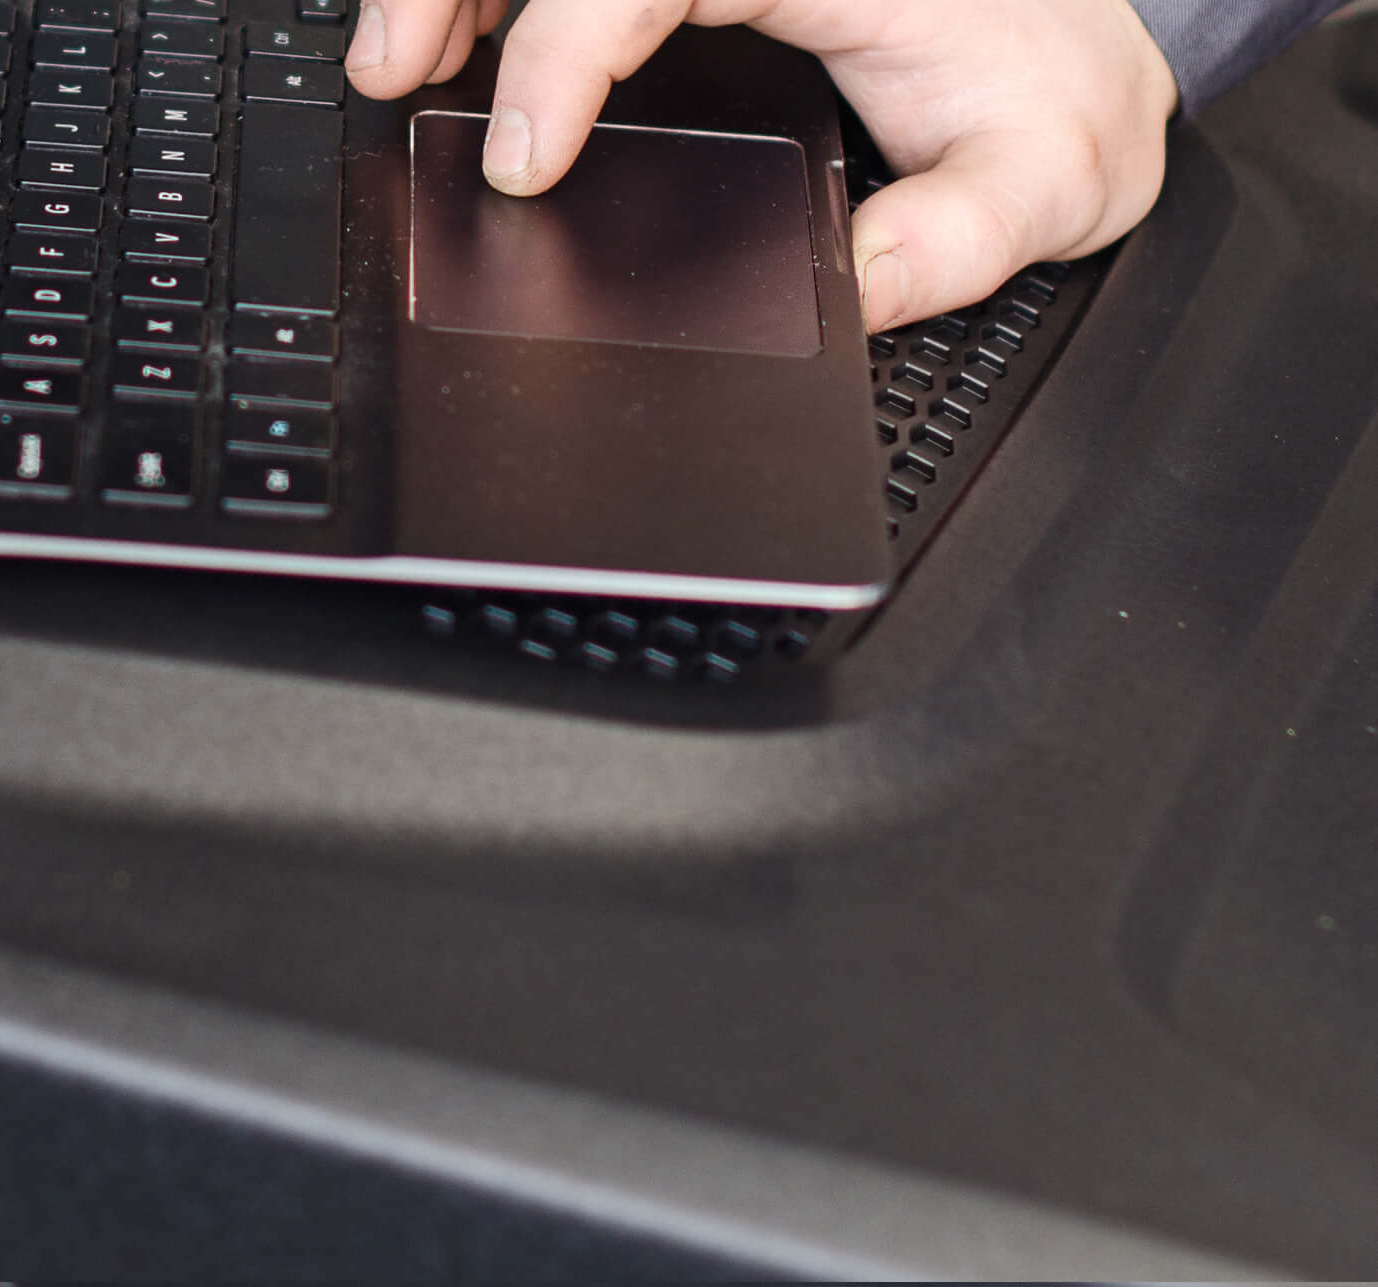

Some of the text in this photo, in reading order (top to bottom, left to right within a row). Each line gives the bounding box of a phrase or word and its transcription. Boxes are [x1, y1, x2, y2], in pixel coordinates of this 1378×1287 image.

[59, 85, 81, 93] K
[165, 110, 187, 120] M
[55, 124, 78, 132] J
[162, 151, 184, 160] N
[51, 163, 73, 172] H
[158, 192, 182, 201] B
[45, 204, 69, 213] G
[156, 233, 179, 241] V
[40, 247, 63, 256] F
[151, 277, 177, 287] C
[34, 290, 61, 301] D
[148, 320, 172, 332] X
[29, 334, 57, 346] S
[142, 366, 171, 379] Z
[25, 380, 50, 393] A
